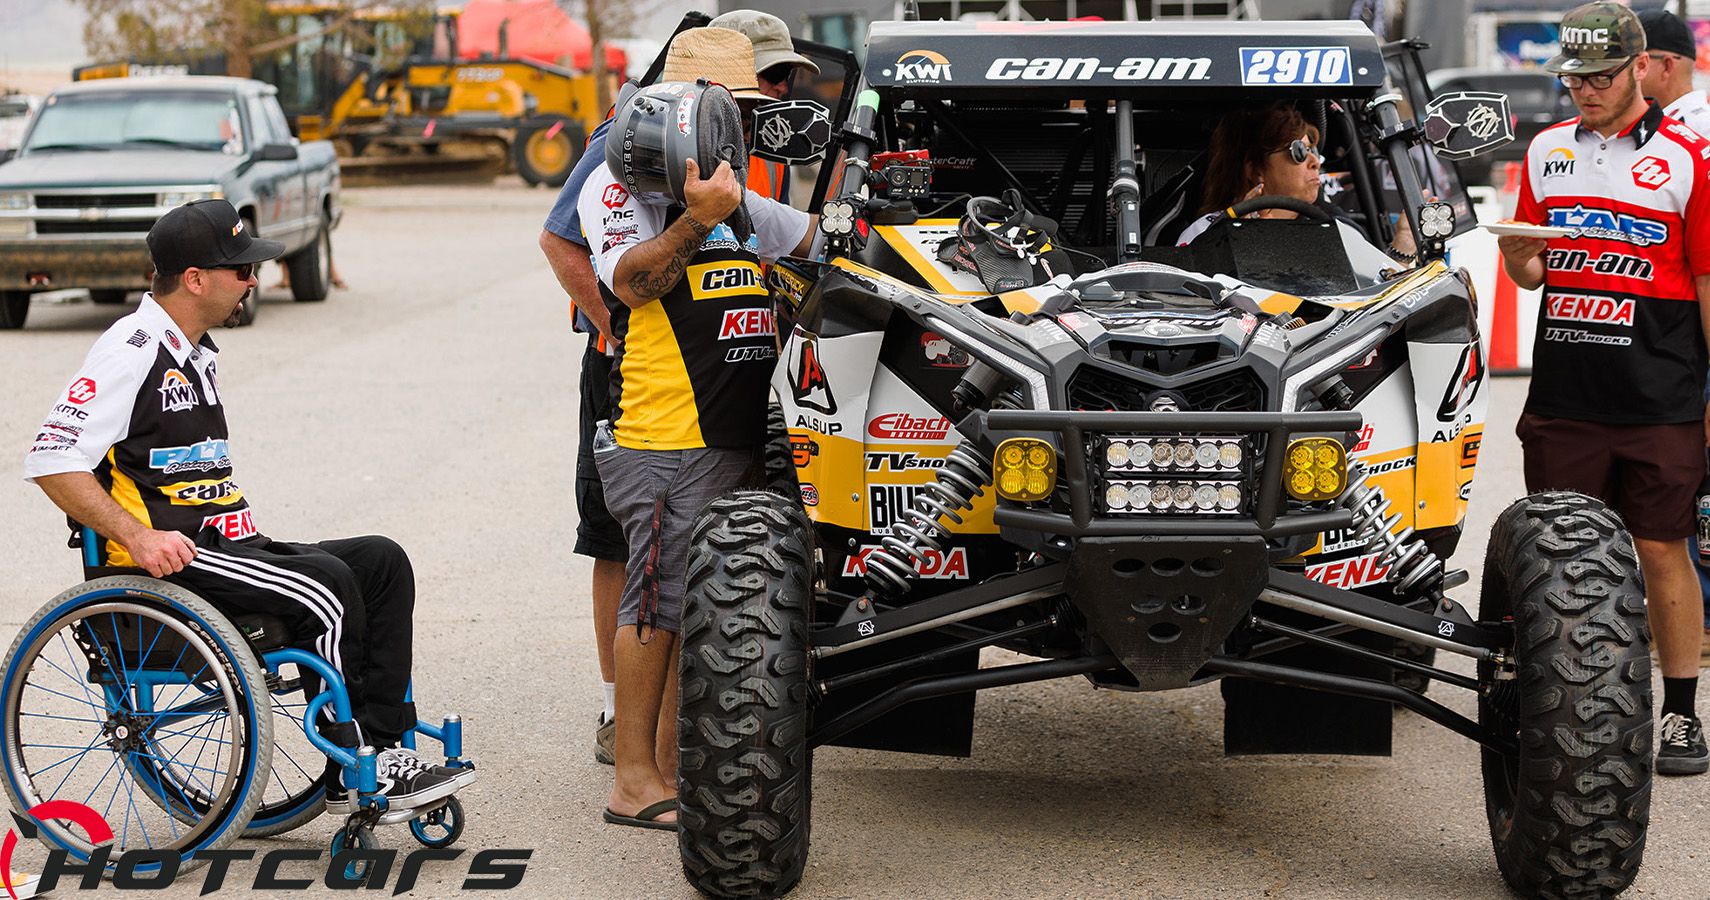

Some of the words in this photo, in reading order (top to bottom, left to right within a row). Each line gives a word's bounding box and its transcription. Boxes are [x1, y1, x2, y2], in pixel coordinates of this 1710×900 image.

[895, 63, 952, 81] KWI
[1246, 50, 1346, 83] 2910
[1543, 159, 1575, 177] KWI
[1547, 249, 1653, 280] an-am
[722, 309, 776, 337] KEN
[795, 414, 843, 436] ALSUP
[868, 413, 951, 440] Eibach
